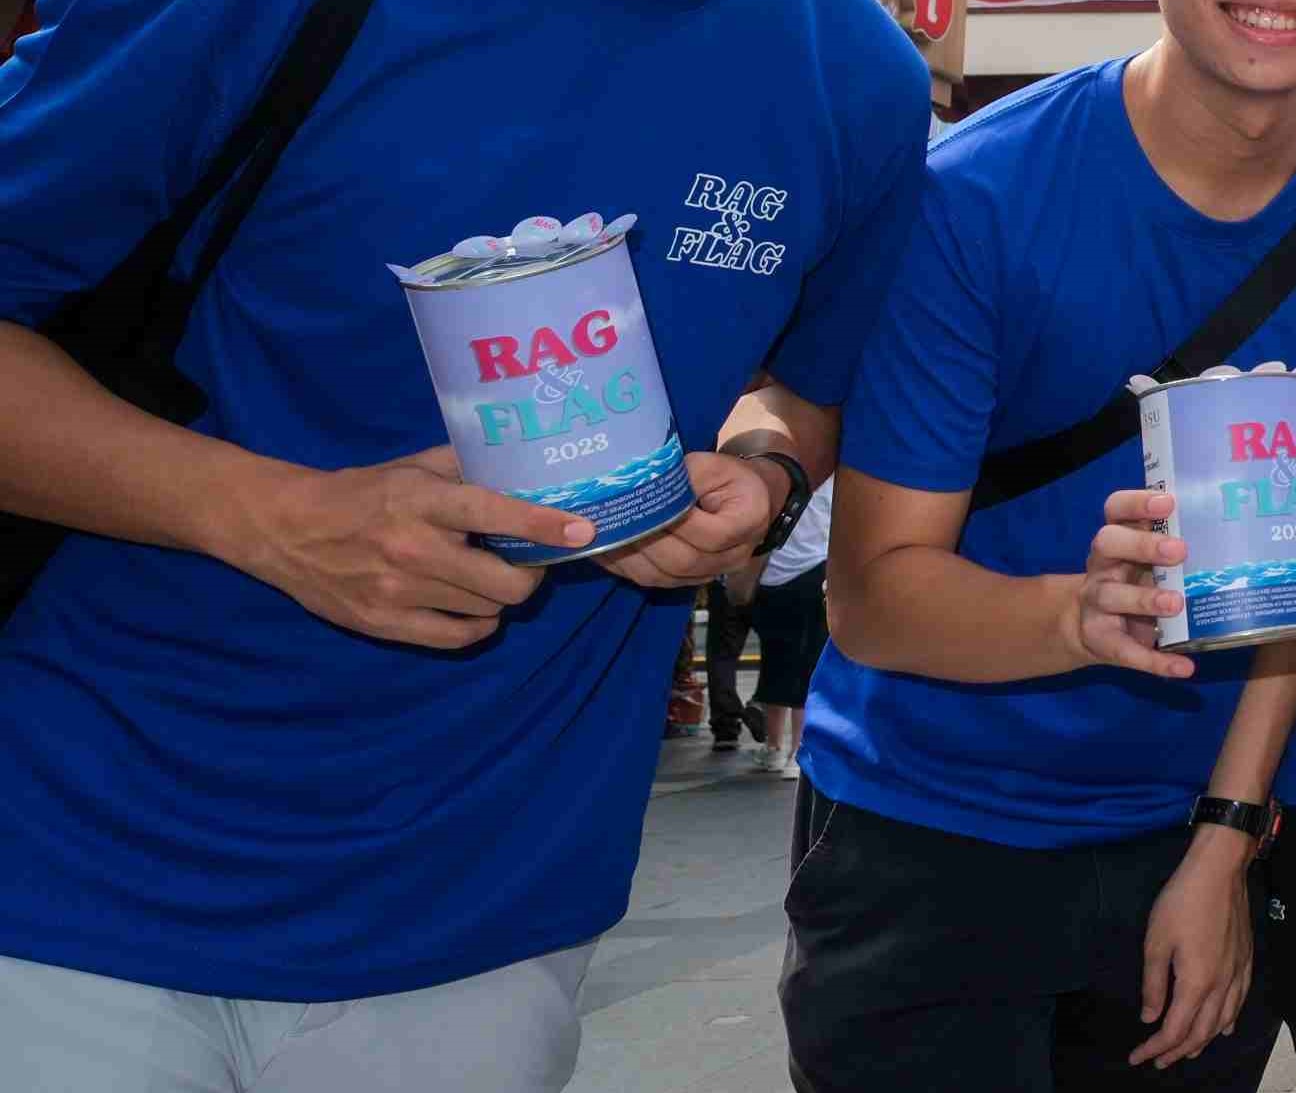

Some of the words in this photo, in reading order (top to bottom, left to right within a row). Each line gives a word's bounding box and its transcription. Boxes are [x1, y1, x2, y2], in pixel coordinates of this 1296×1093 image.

[685, 173, 787, 221] RAG
[667, 227, 786, 275] FLAG
[714, 210, 751, 245] &
[470, 309, 619, 383] RAG
[533, 358, 584, 404] &
[474, 366, 645, 446] FLAG
[543, 433, 609, 466] 2023
